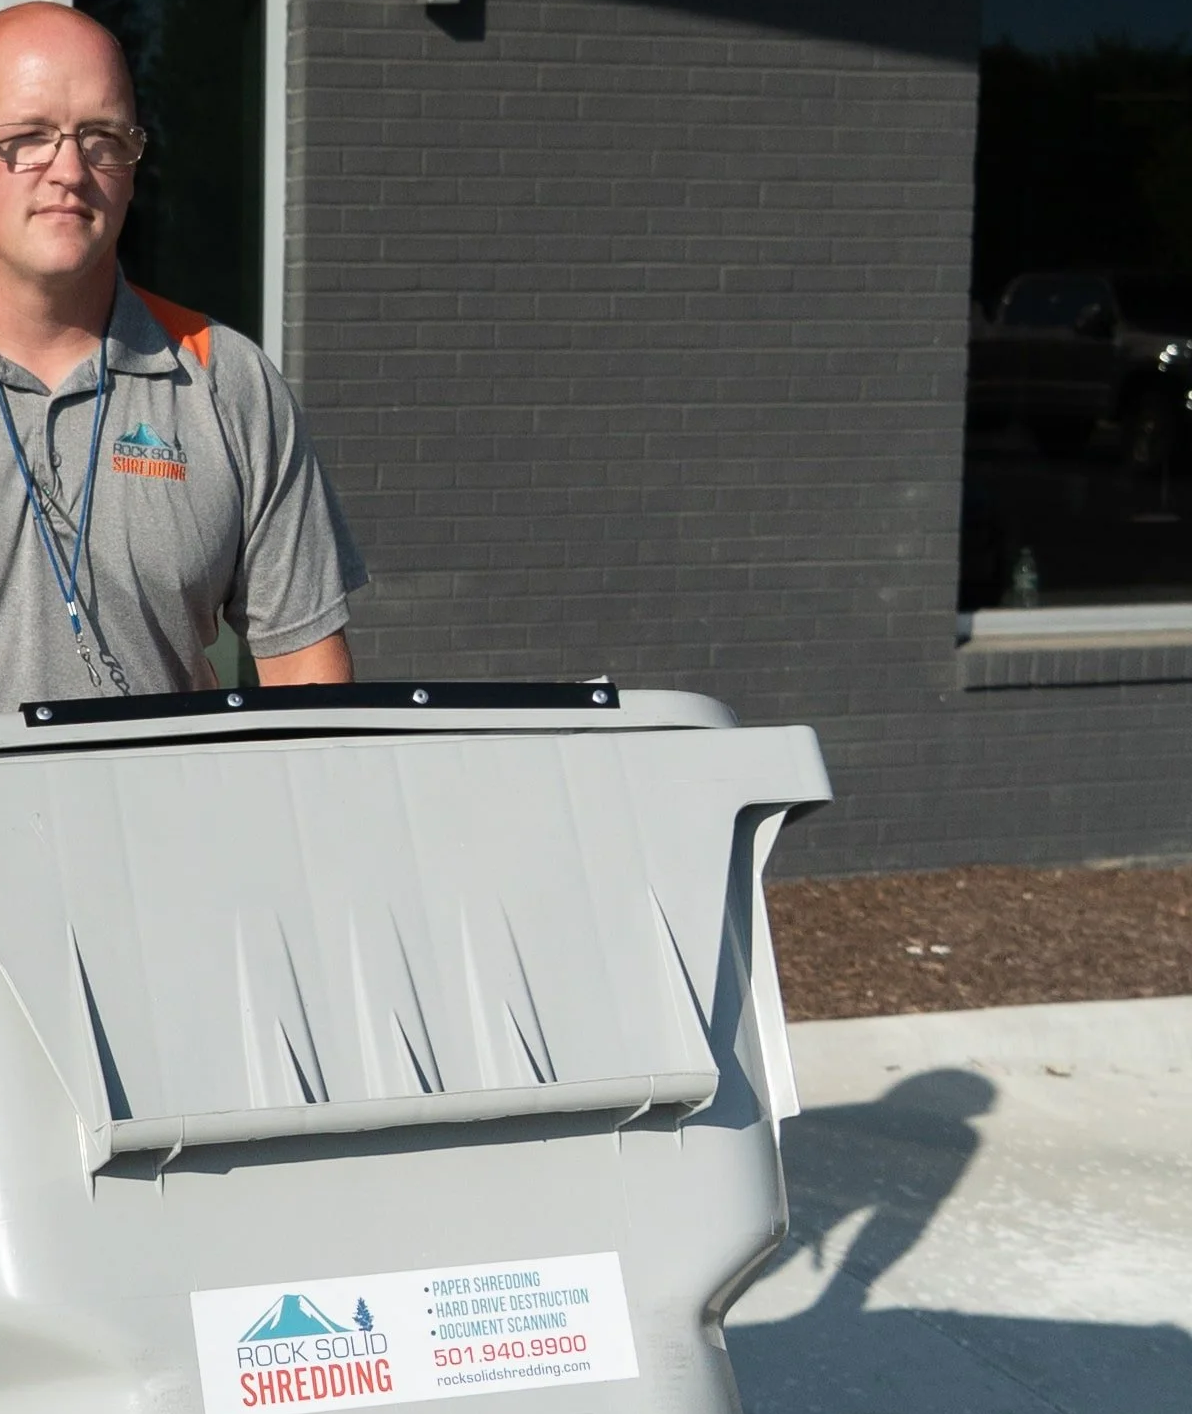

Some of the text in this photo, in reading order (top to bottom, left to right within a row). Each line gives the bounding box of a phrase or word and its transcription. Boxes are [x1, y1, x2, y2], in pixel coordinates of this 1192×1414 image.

[113, 443, 188, 464] ROCK SOLID
[112, 456, 187, 482] SHREDDING
[432, 1271, 541, 1296] PAPER SHREDDING
[436, 1288, 590, 1318] HARD DRIVE DESTRUCTION
[439, 1312, 567, 1340] DOCUMENT SCANNING
[237, 1332, 388, 1369] ROCK SOLID
[434, 1334, 587, 1367] 501.940.9900
[240, 1358, 393, 1407] SHREDDING
[437, 1361, 591, 1387] rocksolidshredding.com
